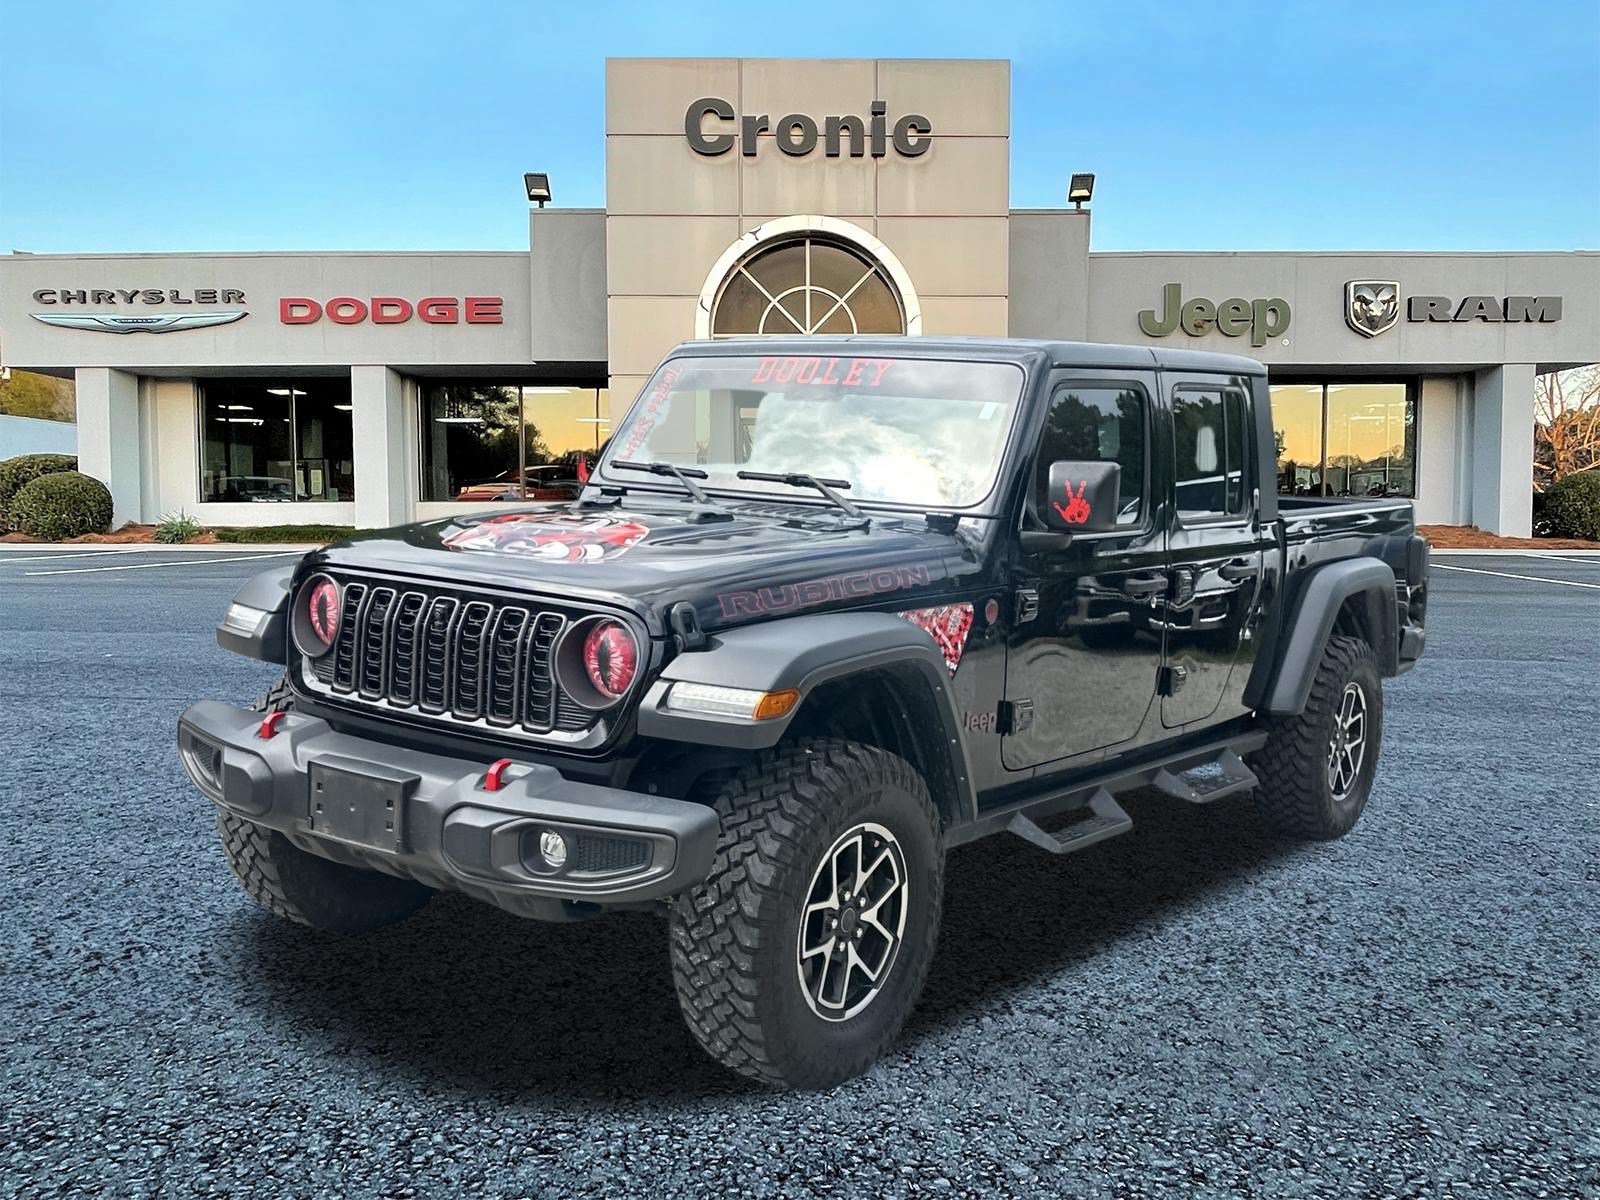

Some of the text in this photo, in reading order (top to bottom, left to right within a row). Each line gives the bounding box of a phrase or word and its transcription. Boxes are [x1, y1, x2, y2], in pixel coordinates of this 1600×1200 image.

[685, 97, 931, 157] Cronic
[32, 289, 246, 304] CHRYSLER
[1407, 296, 1562, 322] RAM
[279, 297, 503, 325] DODGE
[1138, 283, 1291, 347] Jeep
[752, 357, 896, 386] DOOLEY
[717, 565, 931, 618] RUBICON
[964, 711, 997, 733] Jeep
